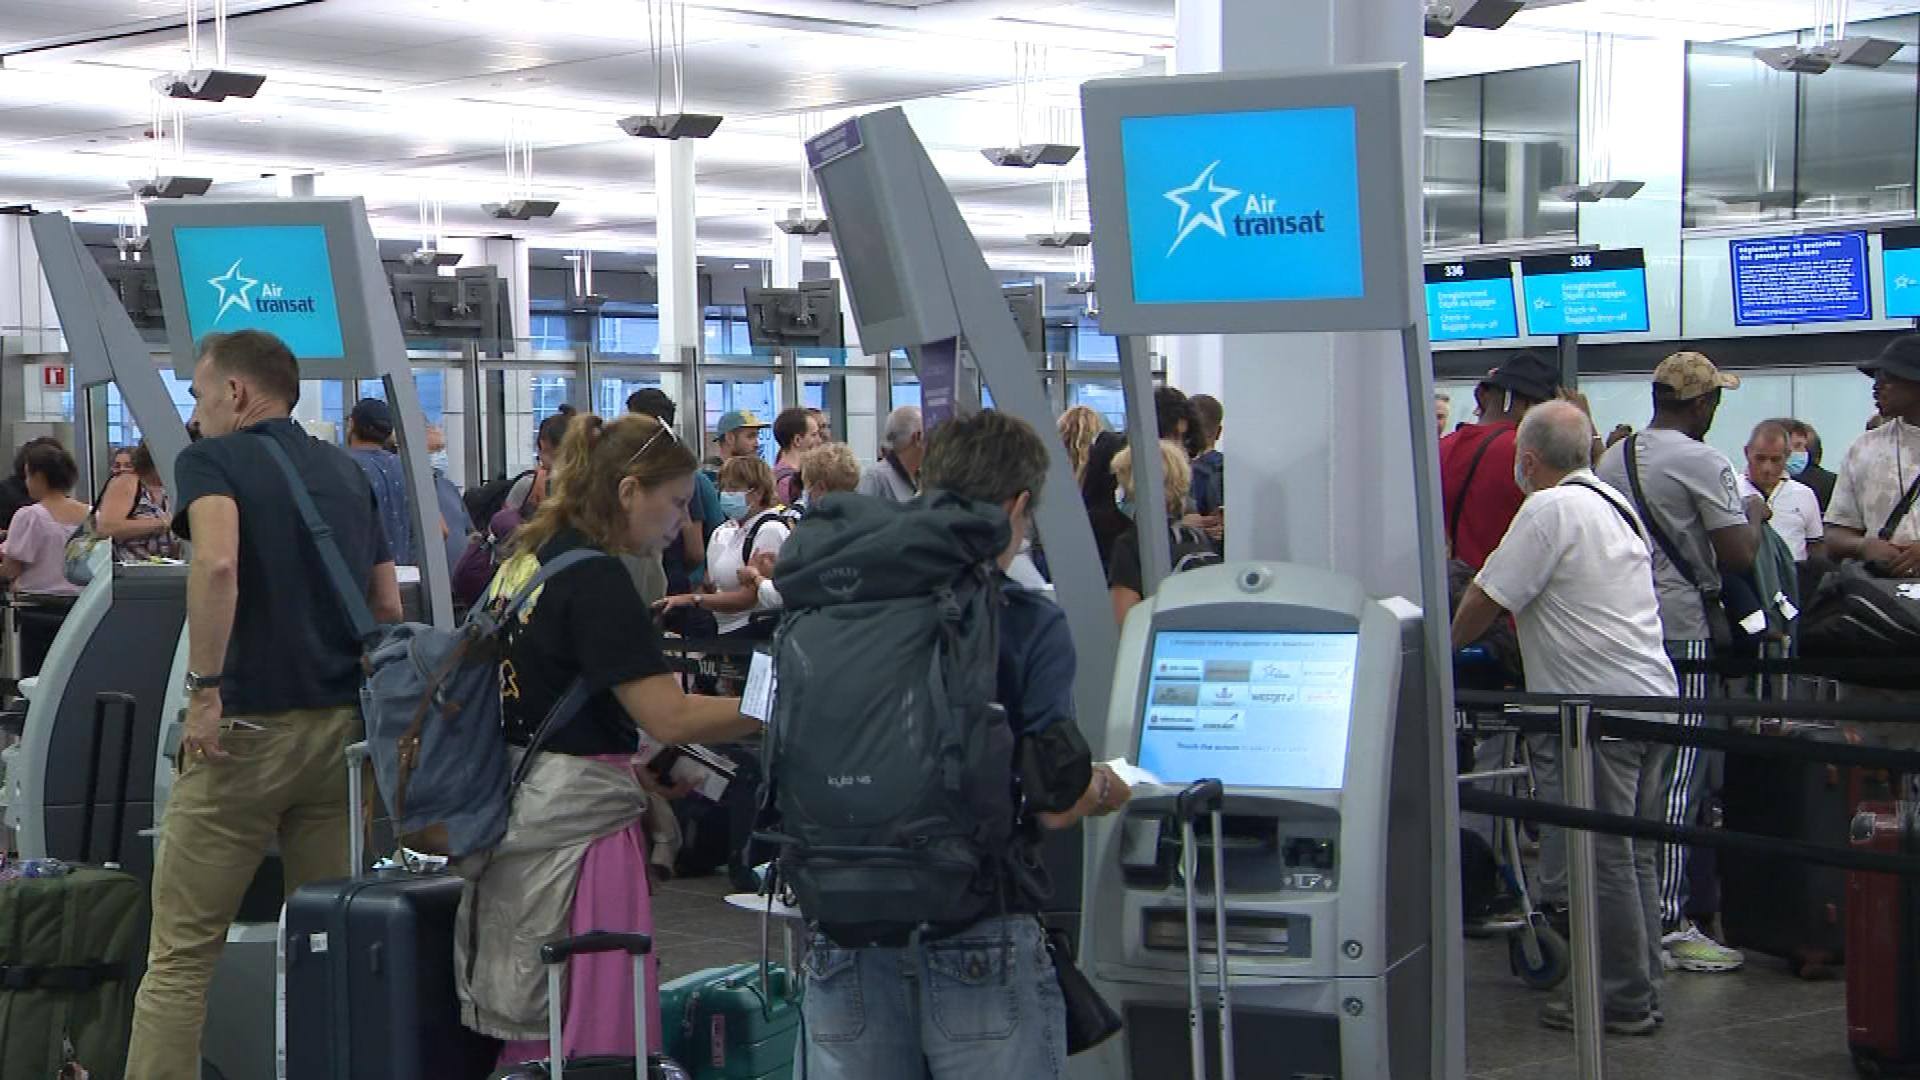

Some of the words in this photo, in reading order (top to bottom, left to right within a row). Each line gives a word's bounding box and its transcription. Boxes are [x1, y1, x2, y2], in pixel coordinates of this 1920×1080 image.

[1244, 193, 1276, 215] Air
[1234, 208, 1325, 237] transat
[1569, 255, 1592, 267] 336
[1444, 265, 1464, 277] 336
[262, 283, 283, 297] Air
[256, 296, 316, 313] transat
